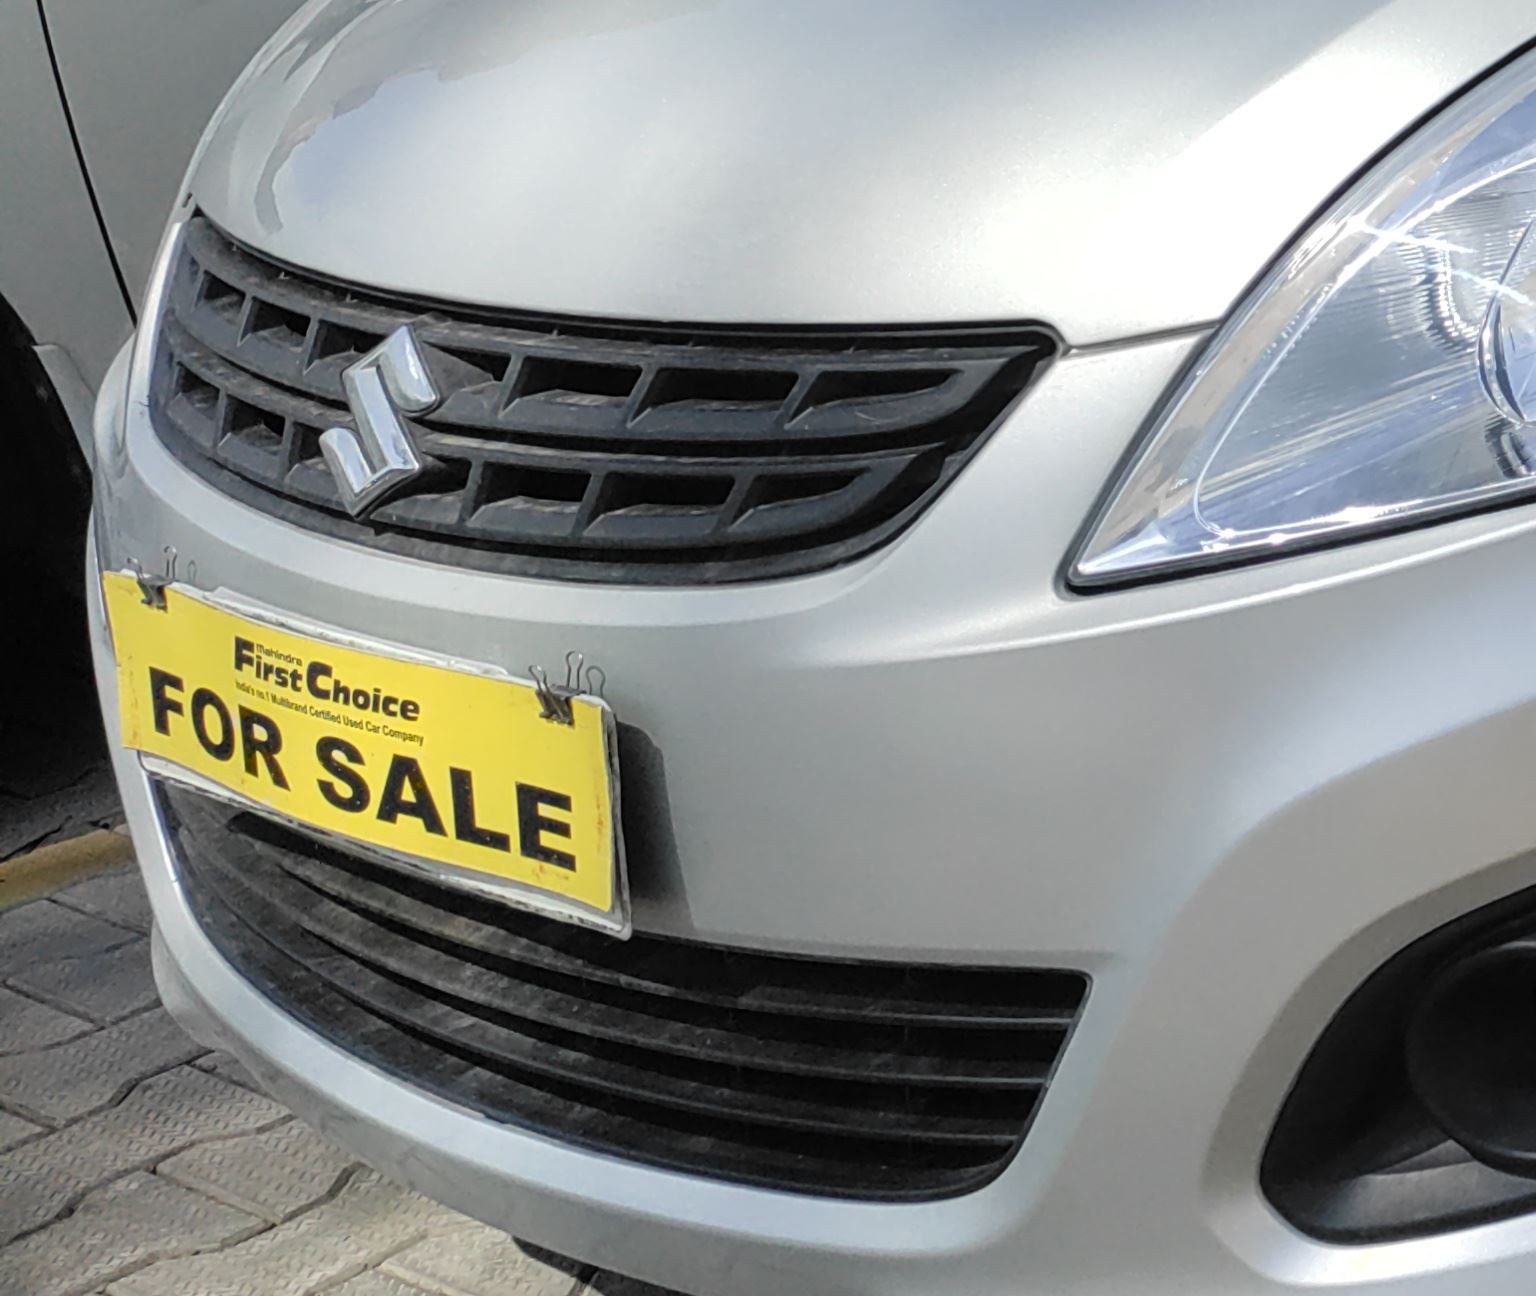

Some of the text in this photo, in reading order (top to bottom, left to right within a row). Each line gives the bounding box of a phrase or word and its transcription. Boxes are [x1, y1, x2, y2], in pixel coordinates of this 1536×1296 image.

[256, 643, 303, 666] Mahindra
[309, 706, 342, 725] Certified
[343, 716, 364, 731] Used
[365, 721, 380, 735] Car
[382, 725, 424, 746] Company
[149, 666, 577, 873] FOR SALE
